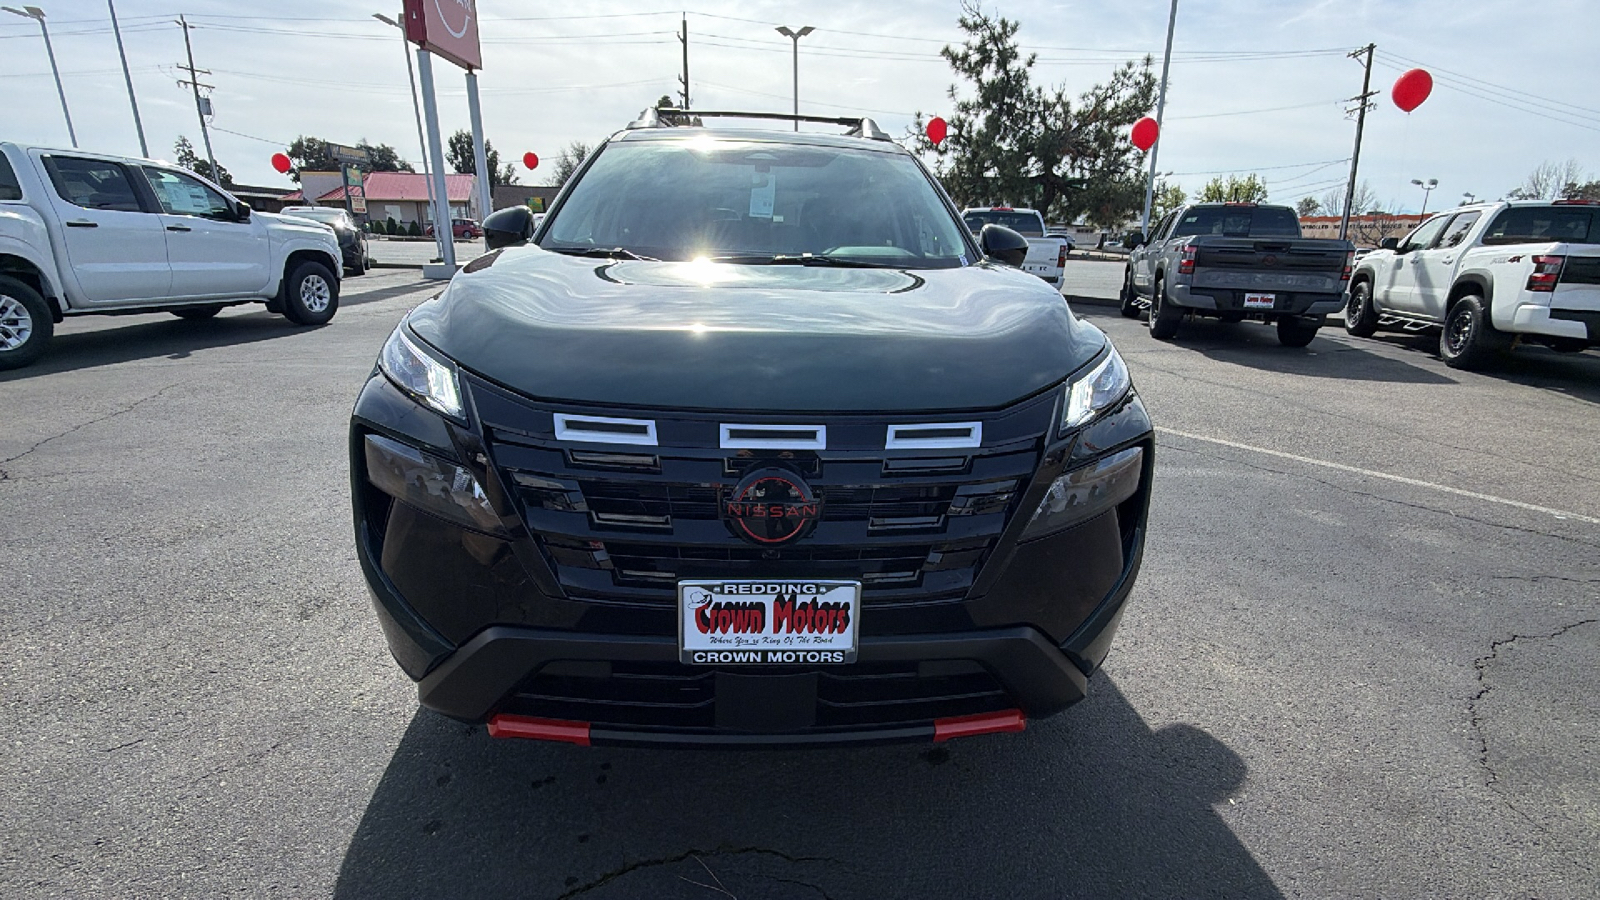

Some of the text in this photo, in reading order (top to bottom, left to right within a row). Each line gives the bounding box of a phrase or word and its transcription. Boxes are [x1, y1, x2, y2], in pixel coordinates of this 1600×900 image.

[727, 502, 817, 517] NISSAN
[723, 584, 817, 594] REDDING
[695, 596, 850, 635] Crown Motors
[709, 636, 733, 644] Where
[762, 636, 781, 645] King
[783, 636, 794, 645] Of
[796, 636, 810, 644] The
[813, 636, 834, 644] Road
[693, 651, 844, 662] CROWN MOTORS
